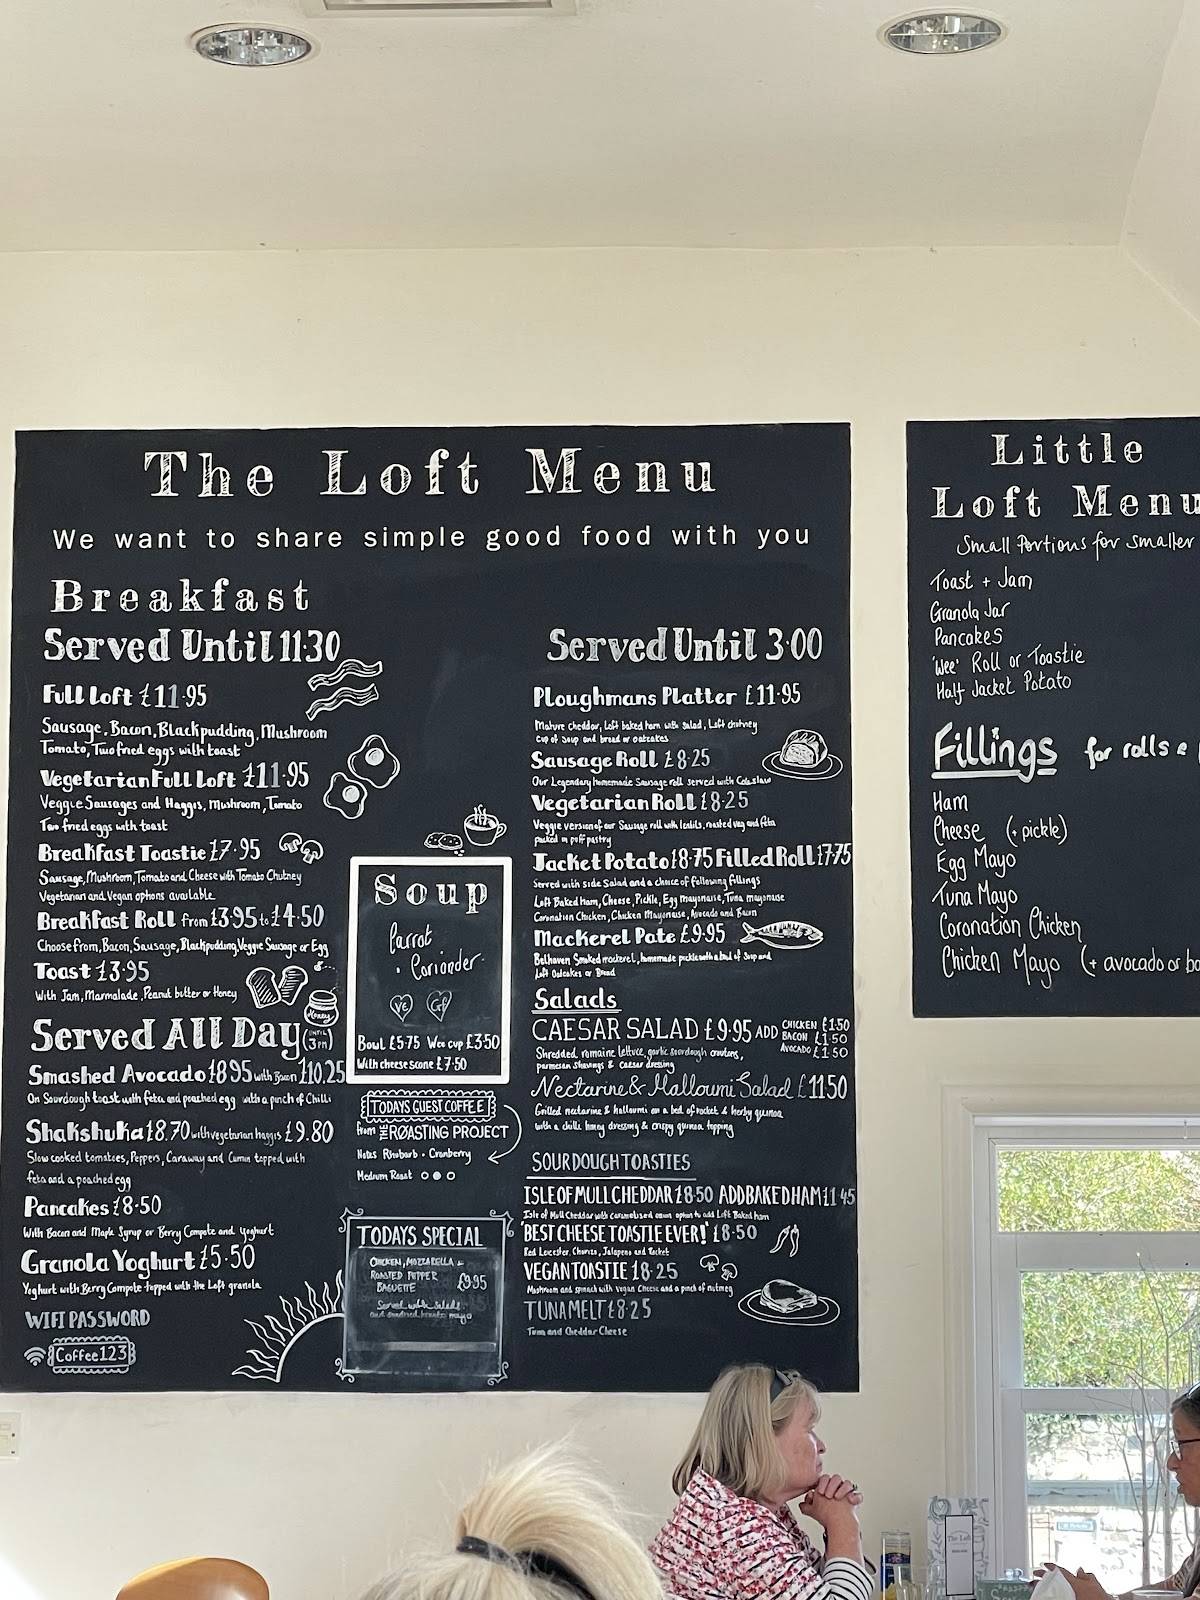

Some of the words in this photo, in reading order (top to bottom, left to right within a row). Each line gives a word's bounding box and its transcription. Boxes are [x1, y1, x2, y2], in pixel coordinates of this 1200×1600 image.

[991, 433, 1142, 465] Little
[144, 451, 273, 497] The
[320, 449, 478, 495] Loft
[525, 448, 716, 494] Menu
[931, 486, 1040, 518] Loft
[1072, 485, 1200, 517] Menu
[53, 529, 93, 549] We
[115, 529, 186, 548] want
[206, 529, 234, 548] to
[257, 528, 341, 548] share
[364, 527, 464, 551] simple
[486, 525, 559, 551] good
[582, 525, 650, 545] food
[672, 525, 735, 545] with
[758, 529, 808, 549] you
[957, 535, 1009, 555] Small
[1017, 535, 1086, 554] Portions
[1092, 531, 1120, 561] for
[1126, 532, 1195, 550] smaller
[930, 569, 973, 591] Toast
[998, 566, 1032, 590] Jam
[50, 578, 308, 612] Breakfast
[930, 601, 979, 623] Granola
[984, 598, 1010, 618] Jar
[44, 628, 171, 663] Served
[181, 629, 274, 662] Until
[547, 627, 668, 662] Served
[673, 627, 757, 661] Until
[935, 625, 1002, 646] Pancakes
[972, 651, 1001, 673] Roll
[1010, 654, 1021, 668] or
[1027, 642, 1085, 665] Toastie
[43, 684, 84, 704] Full
[90, 686, 133, 706] Loft
[534, 686, 656, 712] Ploughmans
[663, 686, 737, 705] Platter
[937, 681, 965, 705] Half
[972, 676, 1015, 697] Jacket
[1024, 670, 1071, 691] Potato
[261, 724, 327, 739] Mushroom
[91, 739, 115, 755] Two
[148, 747, 175, 766] eggs
[179, 740, 205, 756] with
[207, 743, 241, 757] toast
[531, 751, 612, 774] Sausage
[616, 750, 658, 768] Roll
[931, 722, 1057, 783] Fillings
[1084, 737, 1112, 769] for
[1123, 734, 1169, 758] rolls
[40, 770, 149, 792] Vegetarian
[152, 769, 192, 788] Full
[197, 770, 236, 788] Loft
[933, 790, 968, 812] Ham
[934, 815, 986, 848] Cheese
[38, 843, 135, 862] Breakfast
[140, 845, 206, 861] Toastie
[937, 849, 967, 882] Egg
[974, 842, 1017, 878] Mayo
[375, 874, 487, 914] Soup
[932, 878, 973, 906] Tuna
[978, 880, 1017, 916] Mayo
[37, 910, 129, 930] Breakfast
[135, 910, 176, 928] Roll
[259, 913, 269, 926] to
[940, 909, 1021, 939] Coronation
[1029, 906, 1082, 943] Chicken
[34, 963, 91, 980] Toast
[943, 945, 1000, 978] Chicken
[1013, 944, 1060, 989] Mayo
[1104, 947, 1164, 971] avocado
[1168, 958, 1180, 971] or
[35, 990, 56, 1001] With
[144, 986, 172, 1001] Peanut
[213, 985, 237, 1003] Honey
[535, 987, 617, 1009] Salads
[31, 1019, 155, 1051] Served
[162, 1017, 223, 1050] All
[230, 1017, 300, 1063] Day
[532, 1018, 621, 1041] CAESAR
[627, 1018, 698, 1039] SALAD
[755, 1025, 778, 1039] ADD
[358, 1035, 386, 1051] Bowl
[448, 1040, 463, 1051] cup
[29, 1065, 115, 1085] Smashed
[121, 1064, 206, 1083] Avocado
[357, 1057, 378, 1069] With
[531, 1075, 628, 1098] Nectarine
[629, 1075, 646, 1095] &
[648, 1073, 736, 1097] Halloumi
[736, 1071, 793, 1099] Salad
[370, 1100, 410, 1114] TODAYS
[413, 1099, 443, 1114] GUEST
[445, 1100, 484, 1114] COFFEE
[26, 1119, 144, 1143] Shakshuka
[191, 1126, 210, 1139] with
[453, 1125, 509, 1139] PROJECT
[622, 1153, 690, 1170] TOASTIES
[25, 1196, 109, 1217] Pancakes
[356, 1226, 418, 1244] TODAYS
[422, 1226, 483, 1246] SPECIAL
[21, 1249, 109, 1274] Granola
[112, 1249, 195, 1279] Yoghurt
[25, 1311, 65, 1329] WIFI
[69, 1309, 150, 1328] PASSWORD
[56, 1345, 127, 1362] Coffee123
